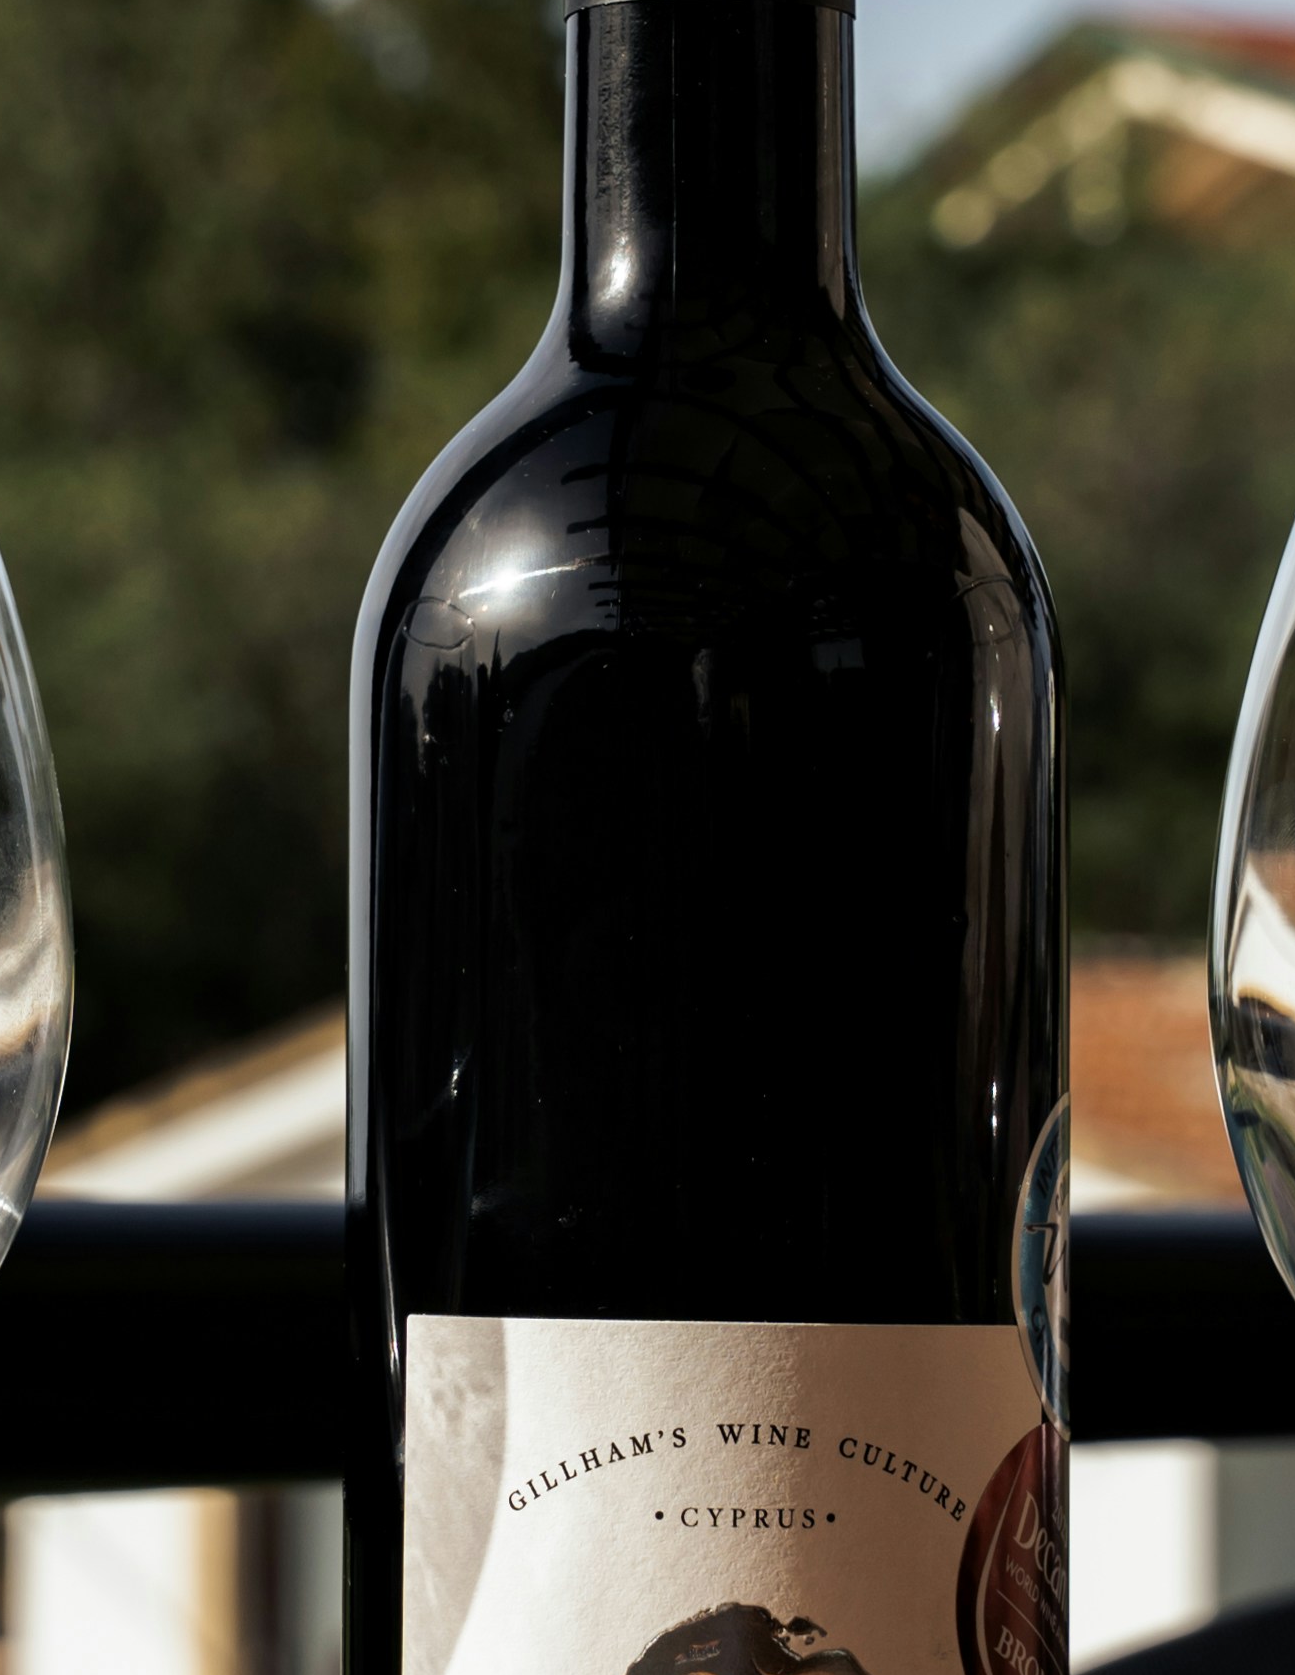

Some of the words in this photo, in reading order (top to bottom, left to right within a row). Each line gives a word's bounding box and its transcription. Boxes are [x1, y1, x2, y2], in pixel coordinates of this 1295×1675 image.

[507, 1426, 688, 1513] GILLHAM'S
[716, 1422, 812, 1450] WINE
[837, 1435, 967, 1524] CULTURE
[680, 1506, 817, 1530] CYPRUS
[1005, 1552, 1040, 1605] WORLD
